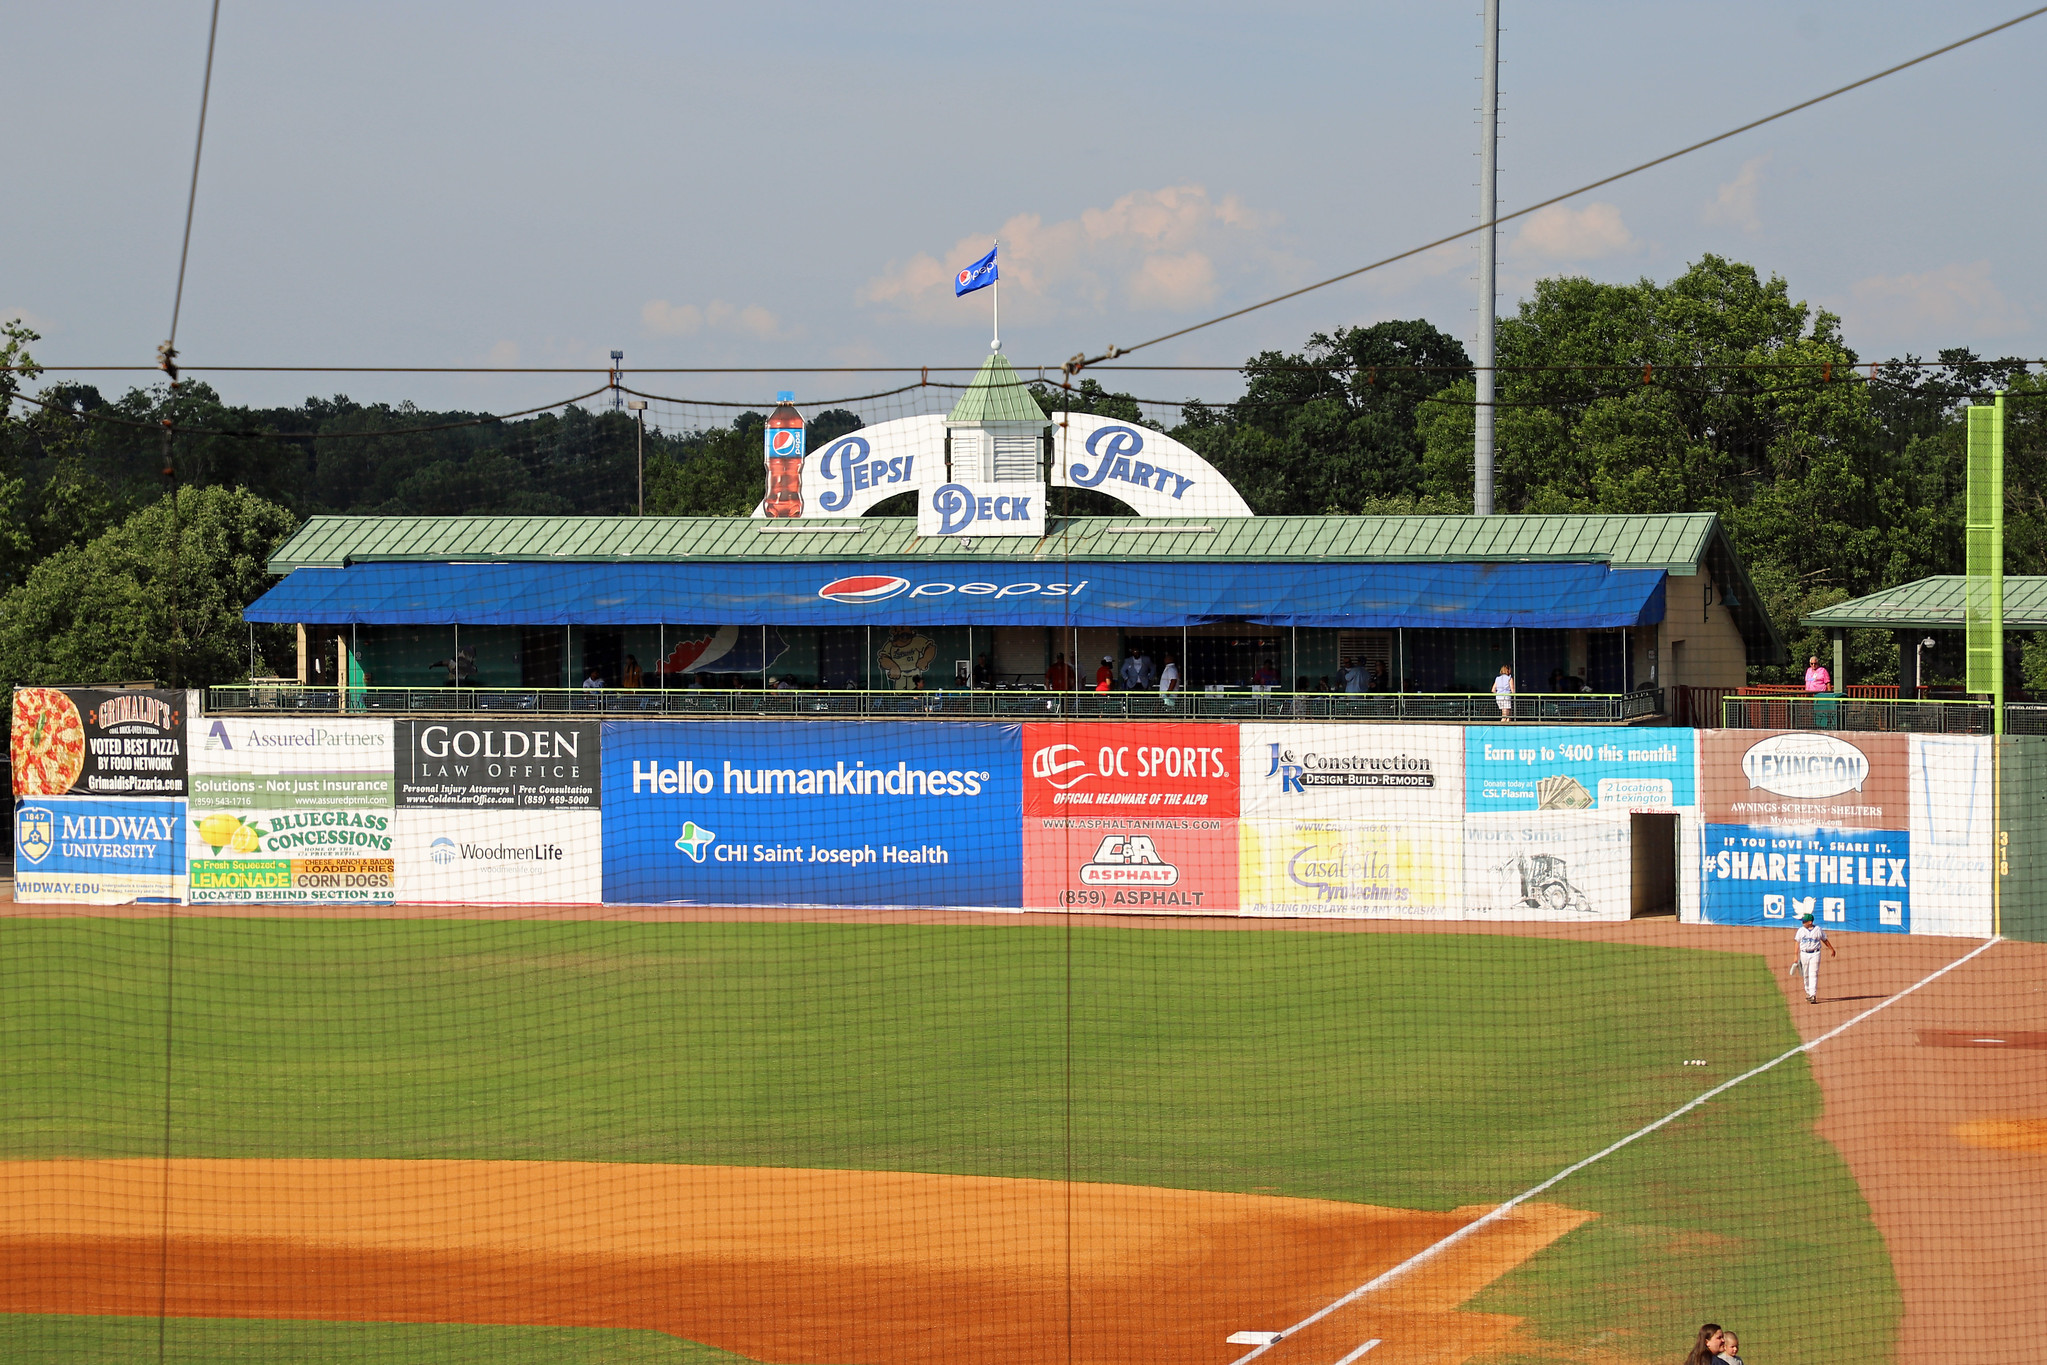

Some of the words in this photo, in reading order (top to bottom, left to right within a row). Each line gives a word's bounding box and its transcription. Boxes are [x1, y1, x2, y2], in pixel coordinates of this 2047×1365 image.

[909, 580, 1089, 599] pepsi
[98, 695, 171, 730] GRIMALDI'S
[247, 728, 385, 747] AssuredPartners
[420, 726, 580, 758] GOLDEN
[89, 738, 122, 755] VOTED
[124, 738, 148, 755] BEST
[150, 739, 179, 756] PIZZA
[1484, 744, 1515, 761] Earn
[1519, 749, 1536, 766] up
[1540, 746, 1555, 761] to
[1559, 744, 1594, 762] $400
[1598, 744, 1624, 762] this
[1627, 744, 1677, 762] month!
[97, 756, 109, 770] BY
[110, 756, 132, 771] FOOD
[134, 757, 173, 771] NETWORK
[1098, 746, 1129, 777] OC
[1303, 753, 1431, 771] Construction
[422, 763, 469, 777] LAW
[488, 763, 580, 778] OFFICE
[632, 760, 714, 794] Hello
[1750, 755, 1862, 789] LEXINGTON
[88, 774, 183, 790] GrimaldisPizzeria.com
[194, 780, 255, 793] Solutions
[266, 780, 291, 792] Not
[293, 780, 319, 794] Just
[323, 779, 388, 792] Insurance
[403, 784, 439, 793] Personal
[441, 785, 466, 795] Injury
[469, 785, 510, 795] Attorneys
[519, 785, 537, 794] Free
[539, 785, 593, 794] Consultation
[1507, 780, 1525, 789] today
[1607, 783, 1613, 791] 2
[1616, 783, 1663, 792] Locations
[194, 797, 214, 806] (859)
[215, 797, 251, 806] 543-1716
[524, 795, 547, 805] (859)
[549, 795, 590, 804] 469-5000
[1053, 793, 1093, 805] OFFICIAL
[1095, 793, 1147, 805] HEADWARE
[1149, 793, 1164, 805] OF
[1164, 793, 1180, 805] THE
[1482, 789, 1500, 798] CSL
[1501, 789, 1535, 798] Plasma
[1604, 793, 1613, 802] in
[1616, 793, 1667, 805] Lexington
[25, 813, 45, 821] 1847
[270, 812, 389, 832] BLUEGRASS
[1043, 820, 1221, 830] WWW.ASPHALTANIMALS.COM
[61, 815, 178, 841] MIDWAY
[1467, 829, 1515, 842] Work
[267, 830, 392, 852] CONCESSIONS
[1724, 837, 1735, 846] IF
[1740, 838, 1766, 847] YOU
[1771, 839, 1802, 849] LOVE
[1808, 840, 1824, 852] IT,
[1830, 841, 1869, 853] SHARE
[1875, 843, 1891, 853] IT.
[62, 843, 157, 859] UNIVERSITY
[460, 843, 563, 860] WoodmenLife
[714, 845, 747, 863] CHI
[752, 844, 804, 863] Saint
[808, 845, 876, 867] Joseph
[882, 845, 949, 864] Health
[204, 860, 229, 870] Fresh
[232, 860, 276, 871] Squeezed
[1288, 845, 1391, 888] Casabella
[191, 872, 289, 888] LEMONADE
[297, 874, 340, 887] CORN
[345, 874, 388, 888] DOGS
[1088, 870, 1171, 880] ASPHALT
[17, 882, 100, 894] MIDWAY.EDU
[192, 890, 251, 900] LOCATED
[256, 890, 307, 900] BEHIND
[311, 890, 369, 899] SECTION
[372, 890, 394, 899] 210
[1058, 890, 1107, 907] (859)
[1113, 890, 1204, 906] ASPHALT
[1253, 903, 1298, 913] AMAZING
[1300, 904, 1348, 913] DISPLAYS
